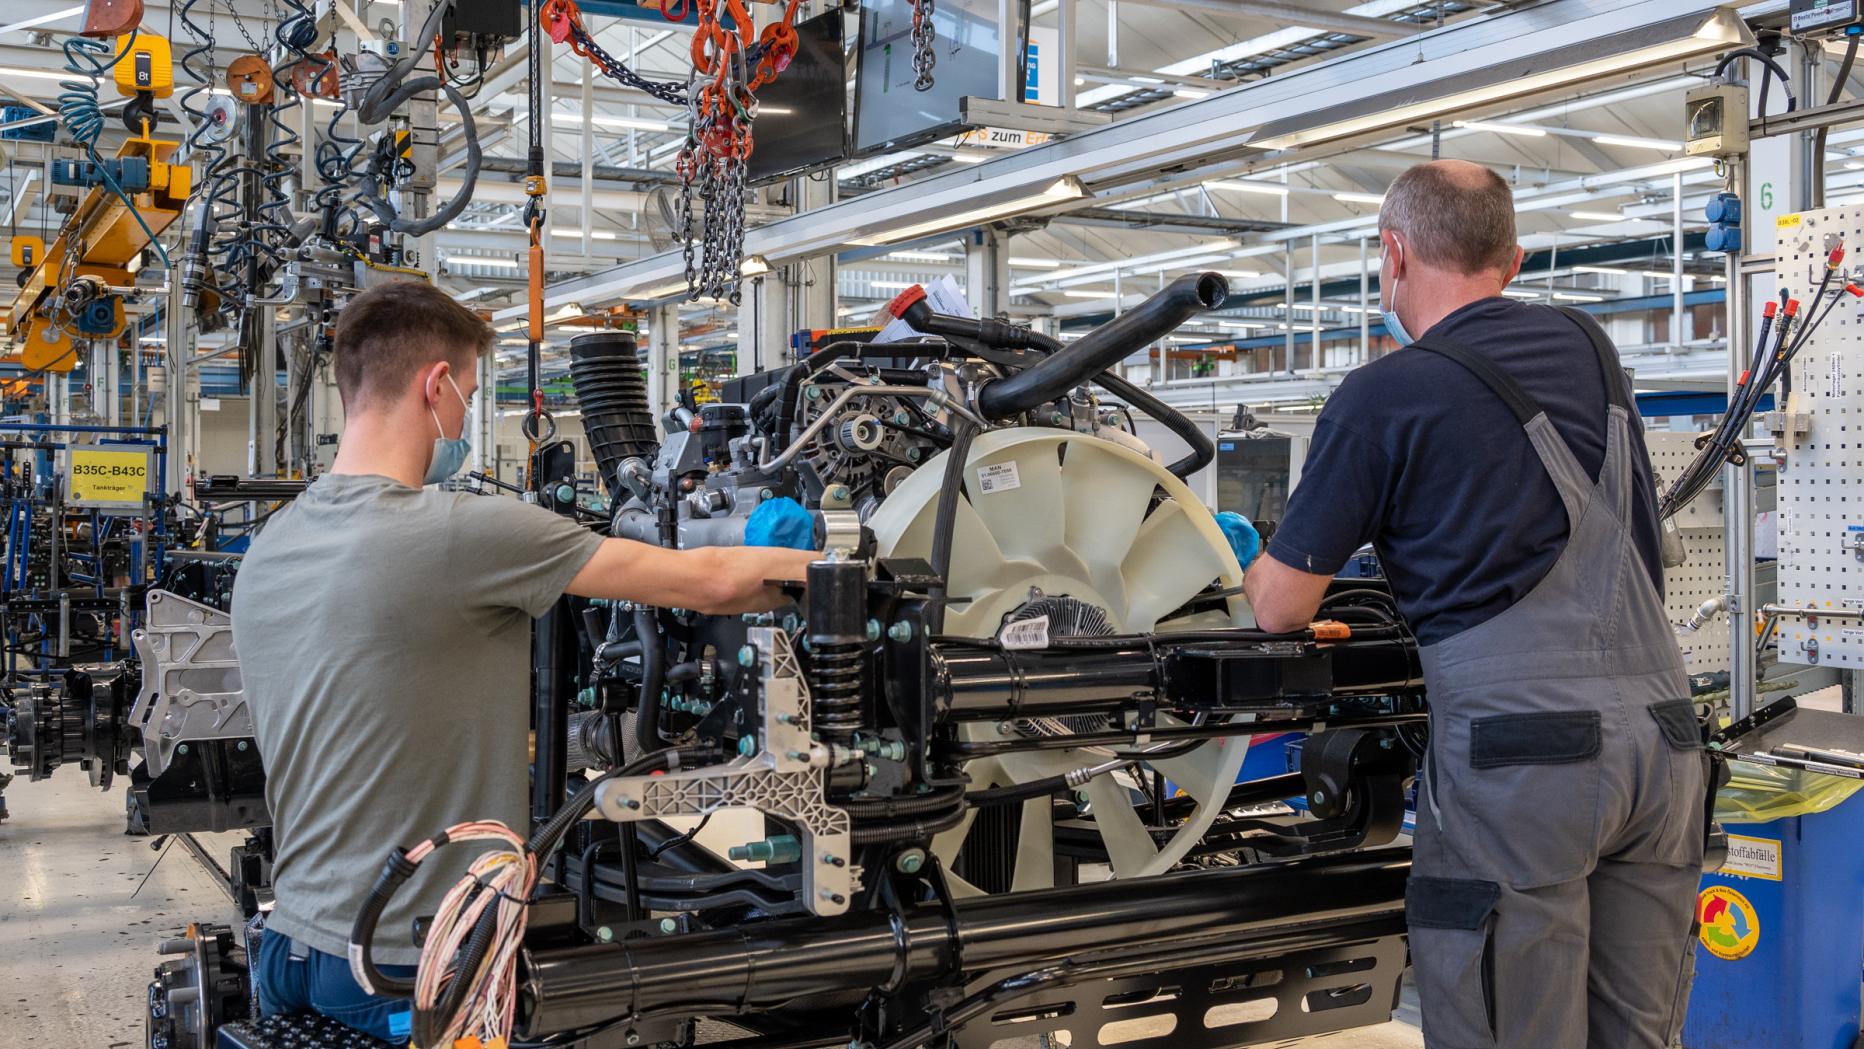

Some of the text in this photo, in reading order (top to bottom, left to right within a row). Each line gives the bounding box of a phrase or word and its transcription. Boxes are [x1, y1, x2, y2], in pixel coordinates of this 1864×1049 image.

[138, 71, 149, 81] 8t
[991, 131, 1021, 143] zum
[73, 464, 145, 477] B35C-B43C
[1727, 845, 1776, 862] stoffabfälle
